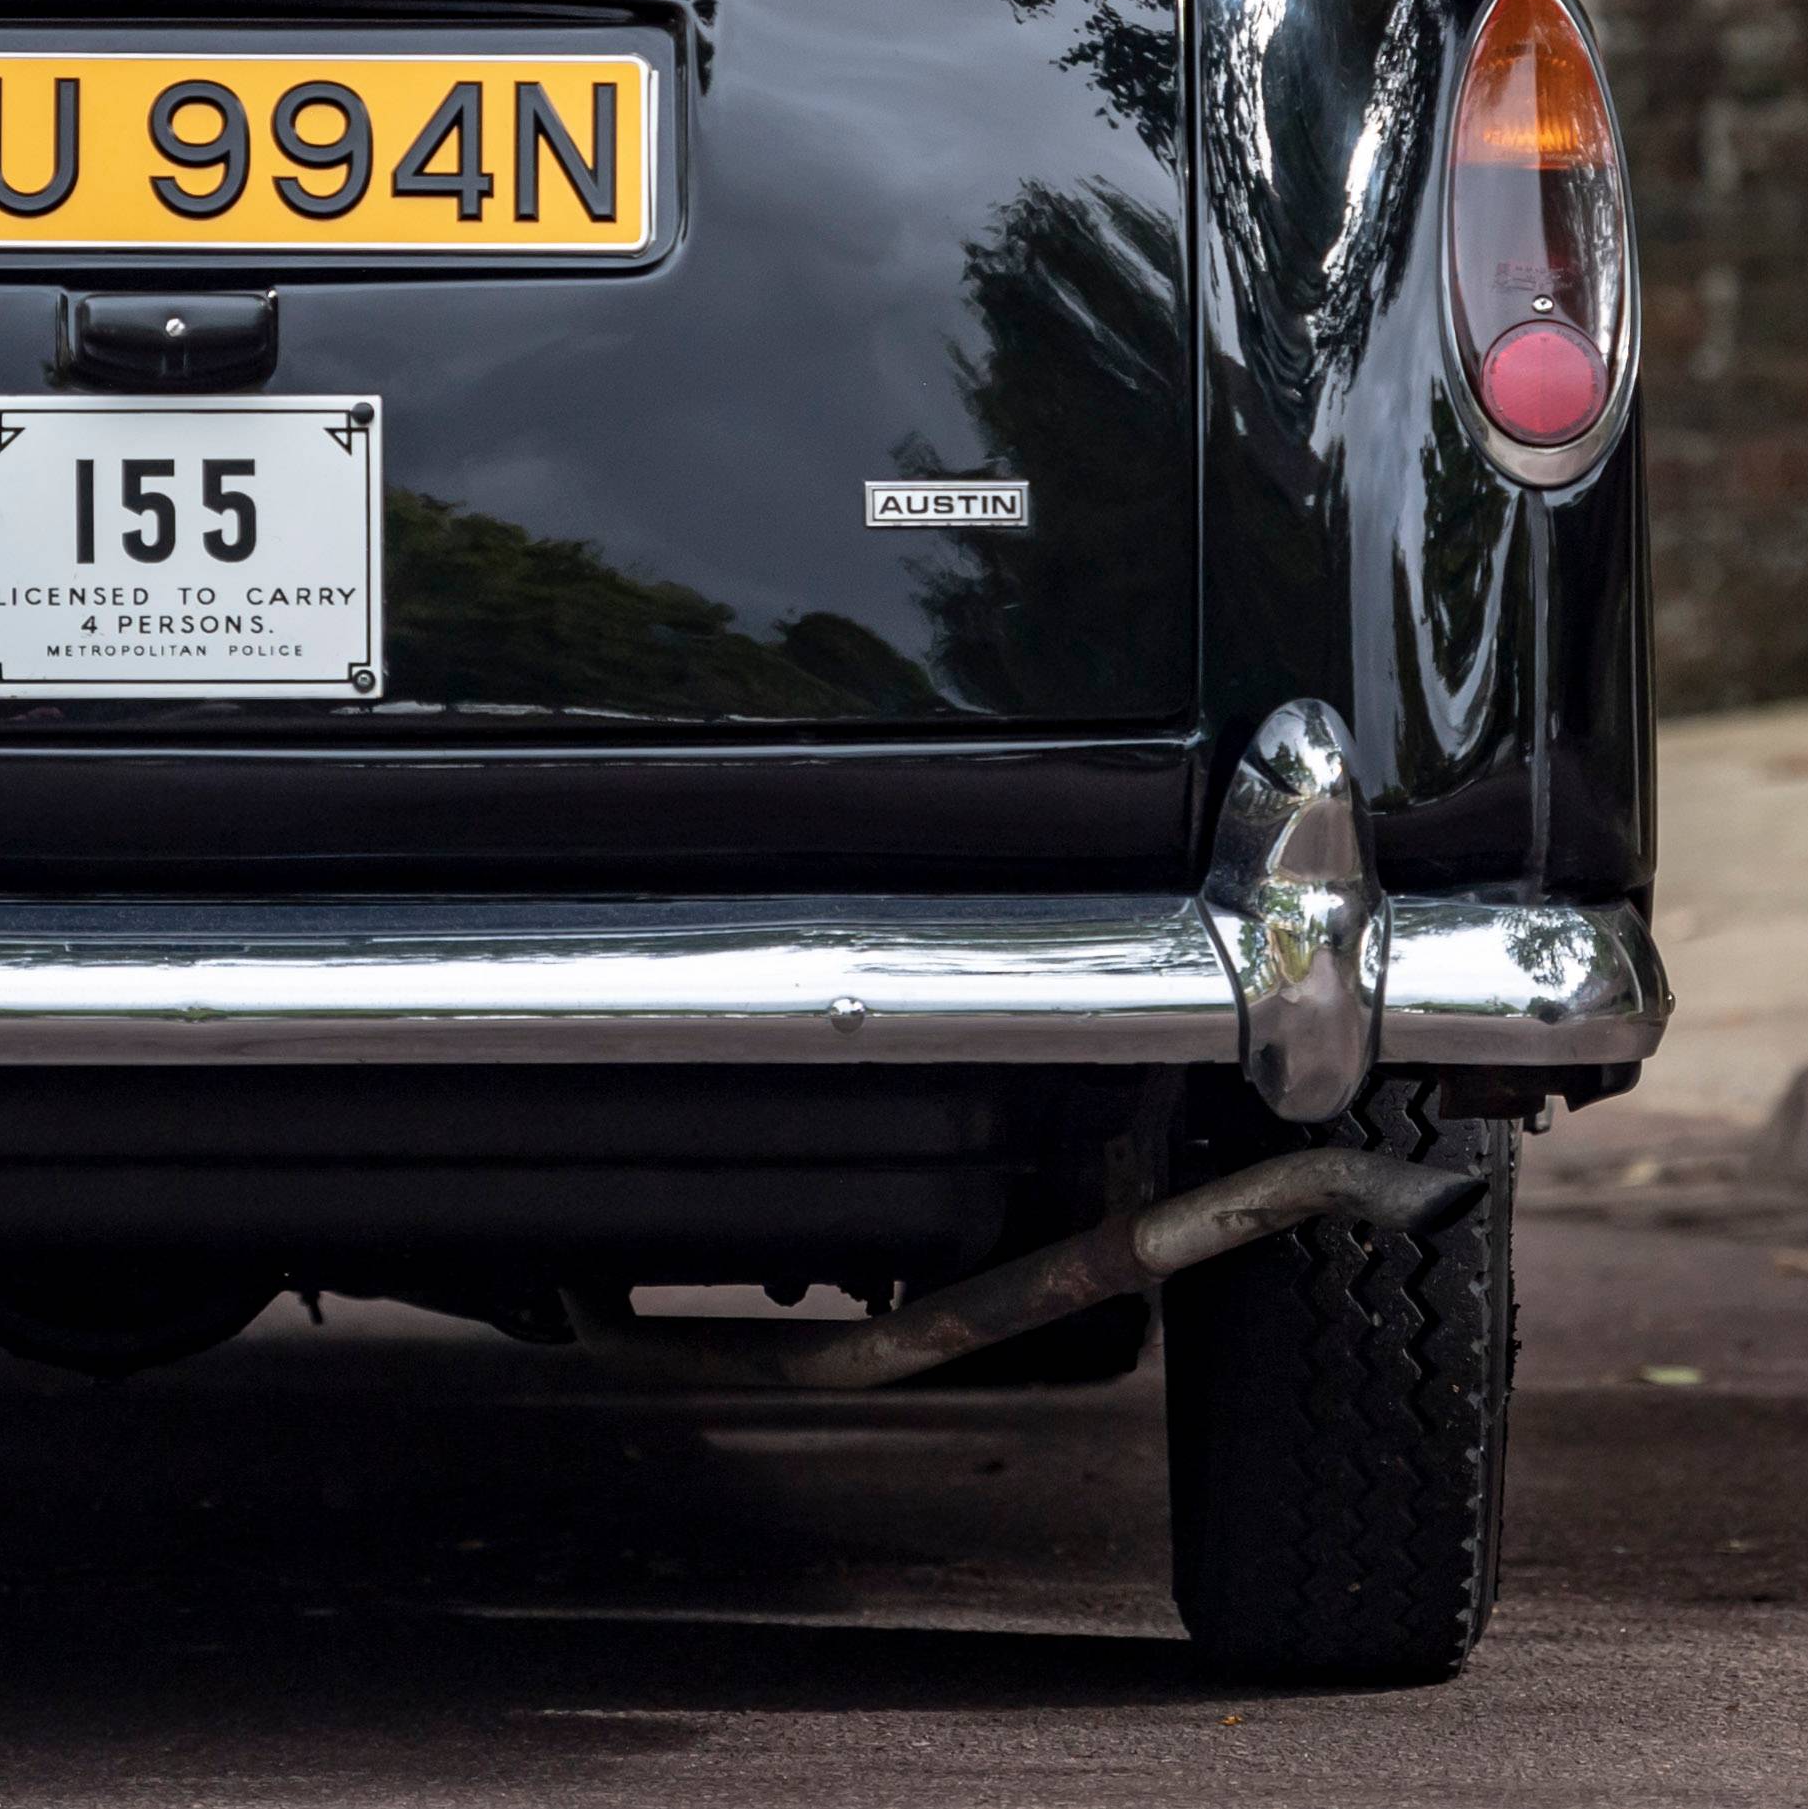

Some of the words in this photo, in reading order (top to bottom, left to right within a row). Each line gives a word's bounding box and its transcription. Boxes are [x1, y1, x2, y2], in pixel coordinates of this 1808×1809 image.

[147, 79, 618, 224] 994N
[76, 458, 257, 564] 155
[879, 495, 1017, 515] AUSTIN
[178, 587, 216, 606] TO
[246, 587, 356, 606] CARRY
[80, 615, 98, 635] 4
[118, 615, 274, 635] PERSONS.
[46, 644, 207, 657] METROPOLITAN
[228, 644, 303, 657] POLICE
